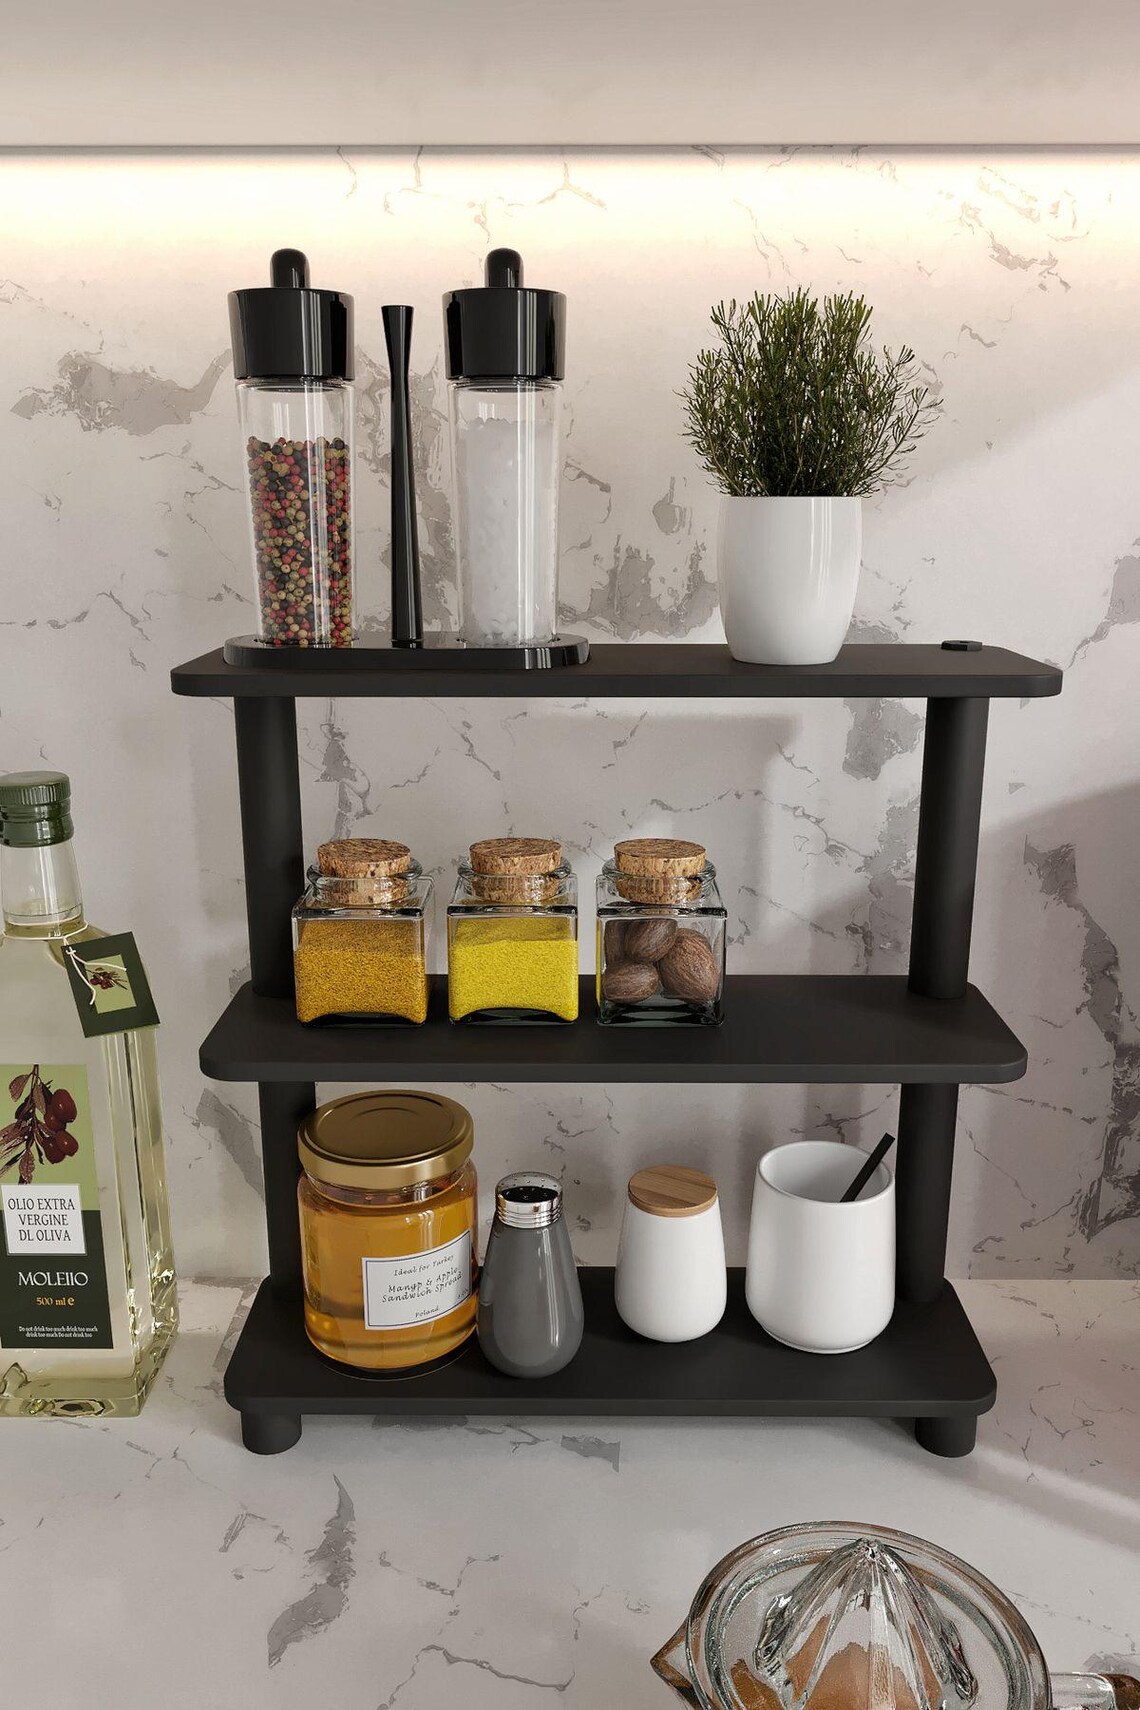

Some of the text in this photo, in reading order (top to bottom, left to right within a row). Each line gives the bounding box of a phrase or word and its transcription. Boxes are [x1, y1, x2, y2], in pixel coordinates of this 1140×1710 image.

[8, 1198, 75, 1210] OLIO EXTRA
[18, 1214, 68, 1226] VERGINE
[36, 1229, 71, 1241] OLIVA
[36, 1297, 53, 1306] 500
[55, 1297, 66, 1306] ml
